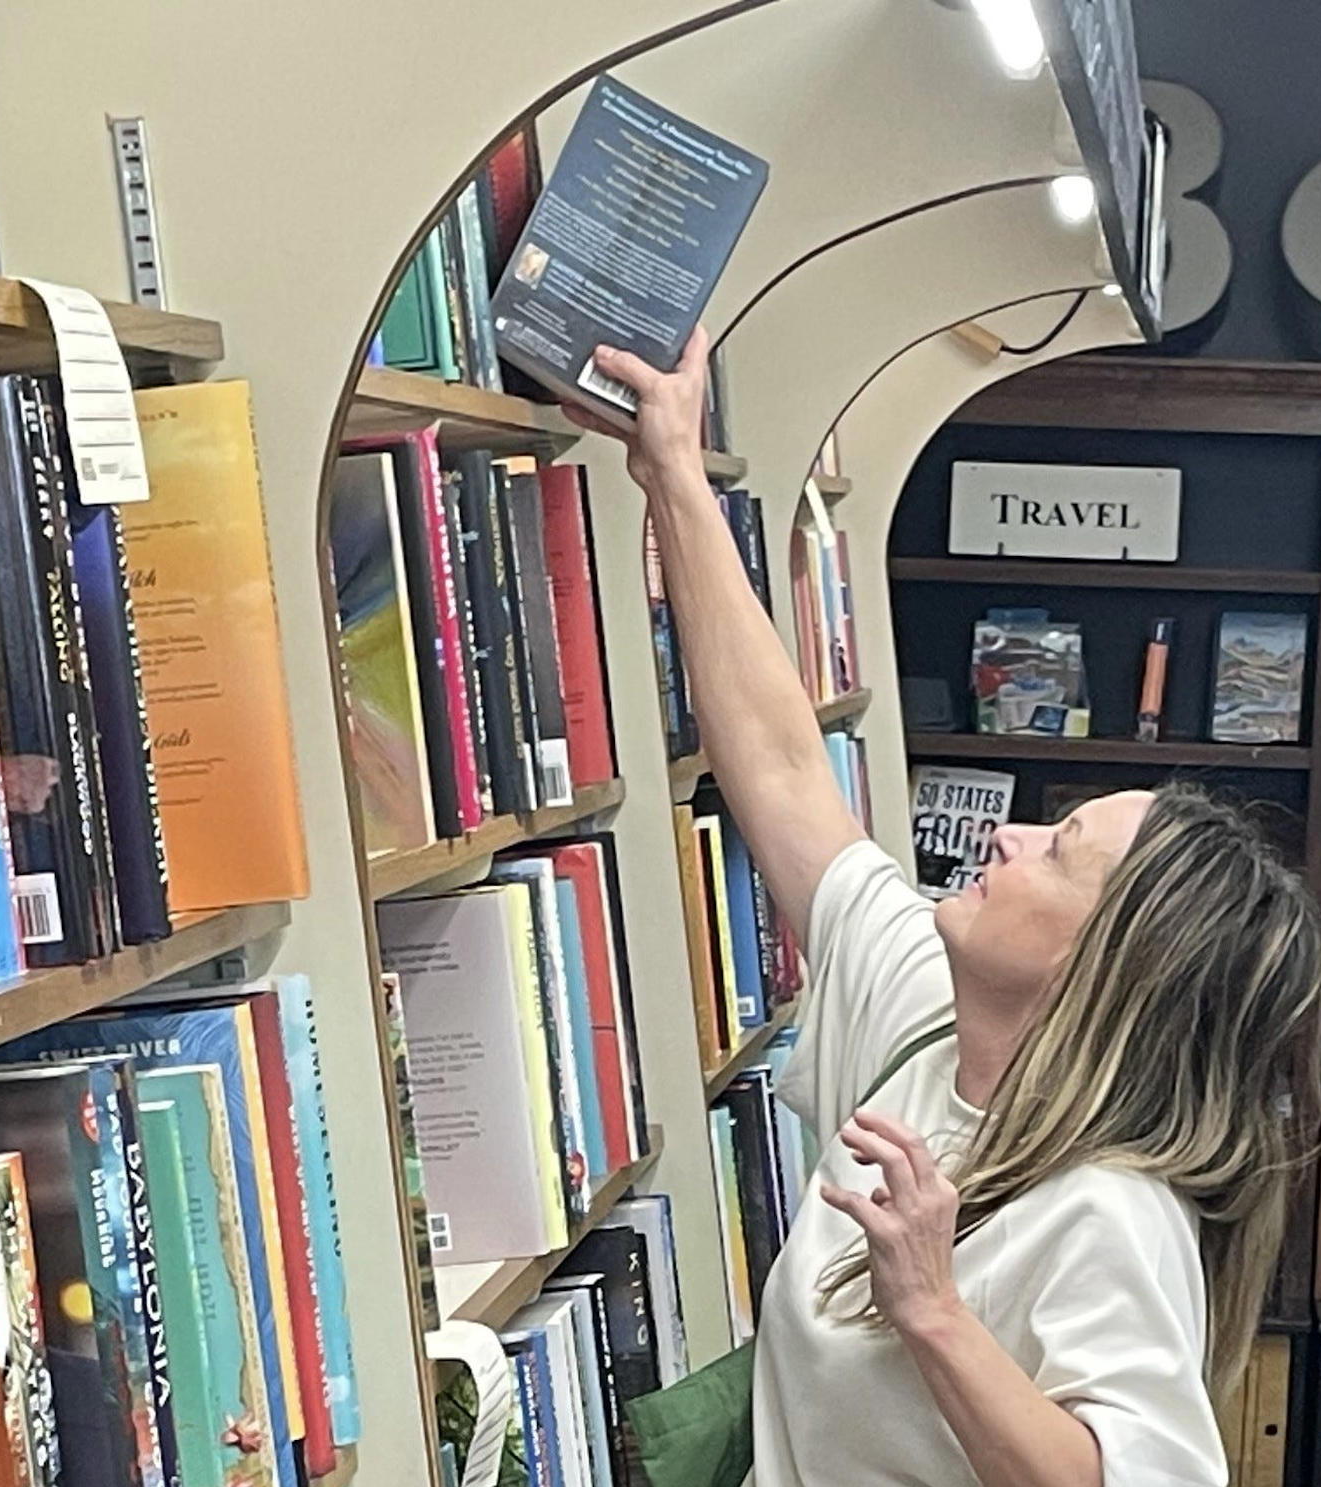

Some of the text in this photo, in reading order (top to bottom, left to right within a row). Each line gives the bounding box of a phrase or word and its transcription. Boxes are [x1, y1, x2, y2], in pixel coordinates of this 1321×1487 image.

[990, 491, 1141, 531] TRAVEL
[943, 784, 1006, 815] STATES
[116, 1037, 183, 1058] RIVER
[126, 1142, 172, 1407] BABYLONIA
[628, 1251, 651, 1348] KING
